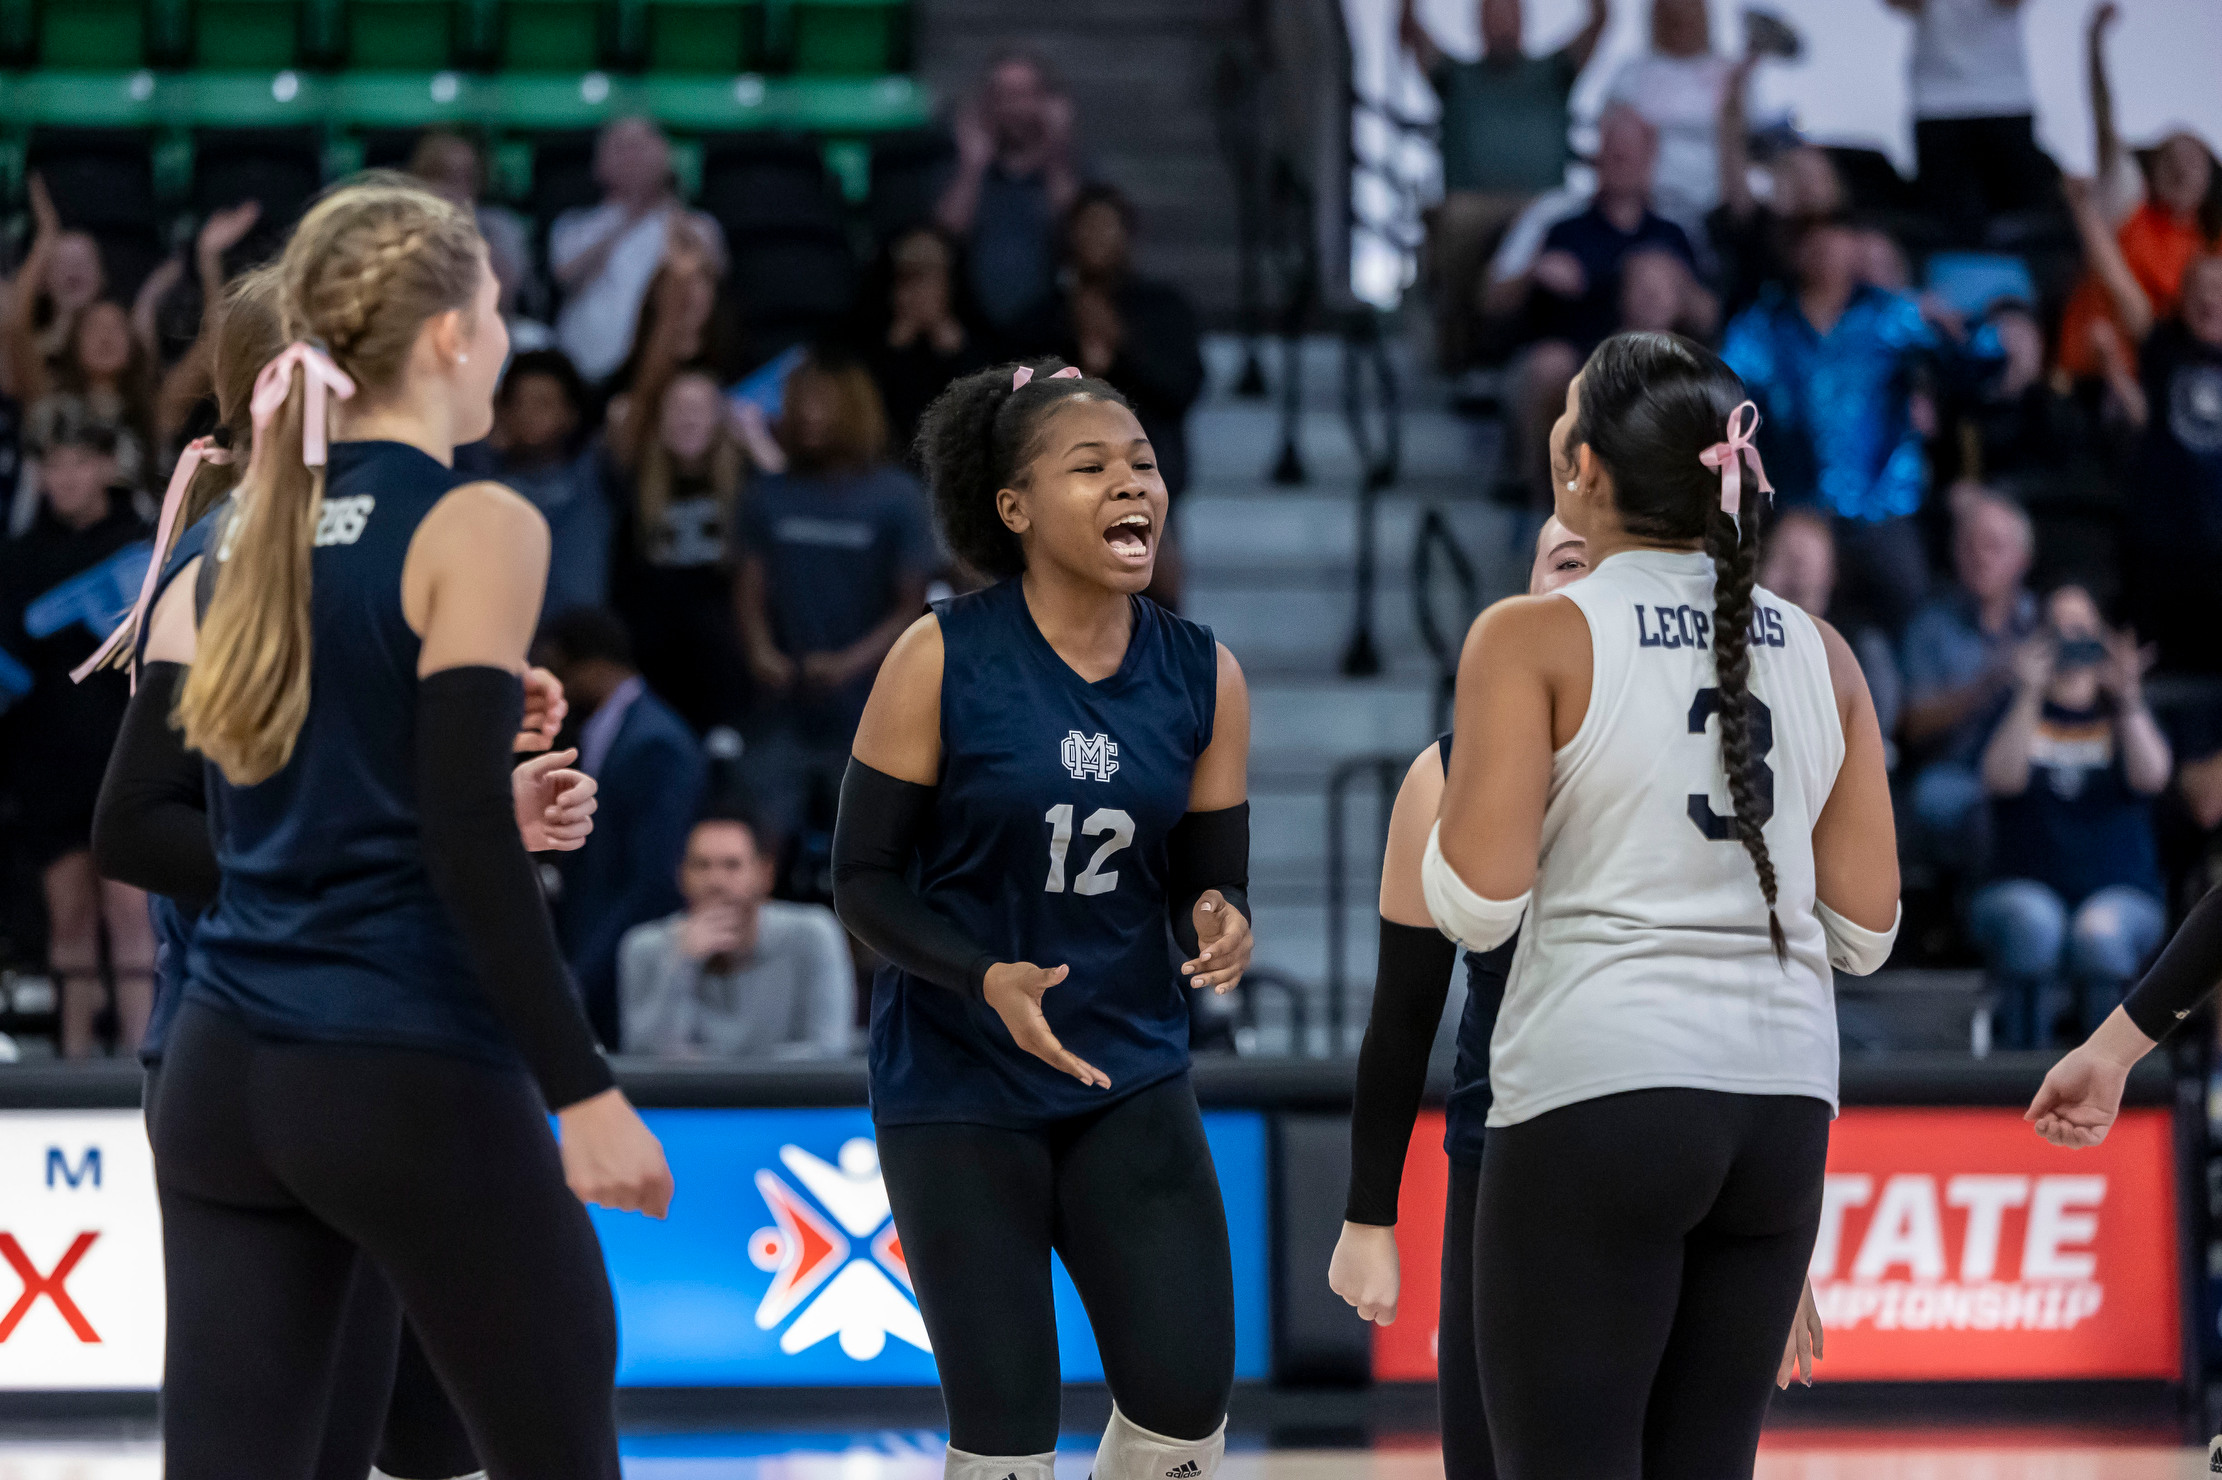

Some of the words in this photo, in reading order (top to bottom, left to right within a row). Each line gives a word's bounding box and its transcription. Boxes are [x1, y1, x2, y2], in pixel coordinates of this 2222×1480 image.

[1634, 605, 1785, 650] LEOPDS
[1686, 687, 1775, 841] 3
[1044, 803, 1136, 896] 12
[45, 1147, 102, 1188] M
[1808, 1173, 2107, 1282] TATE
